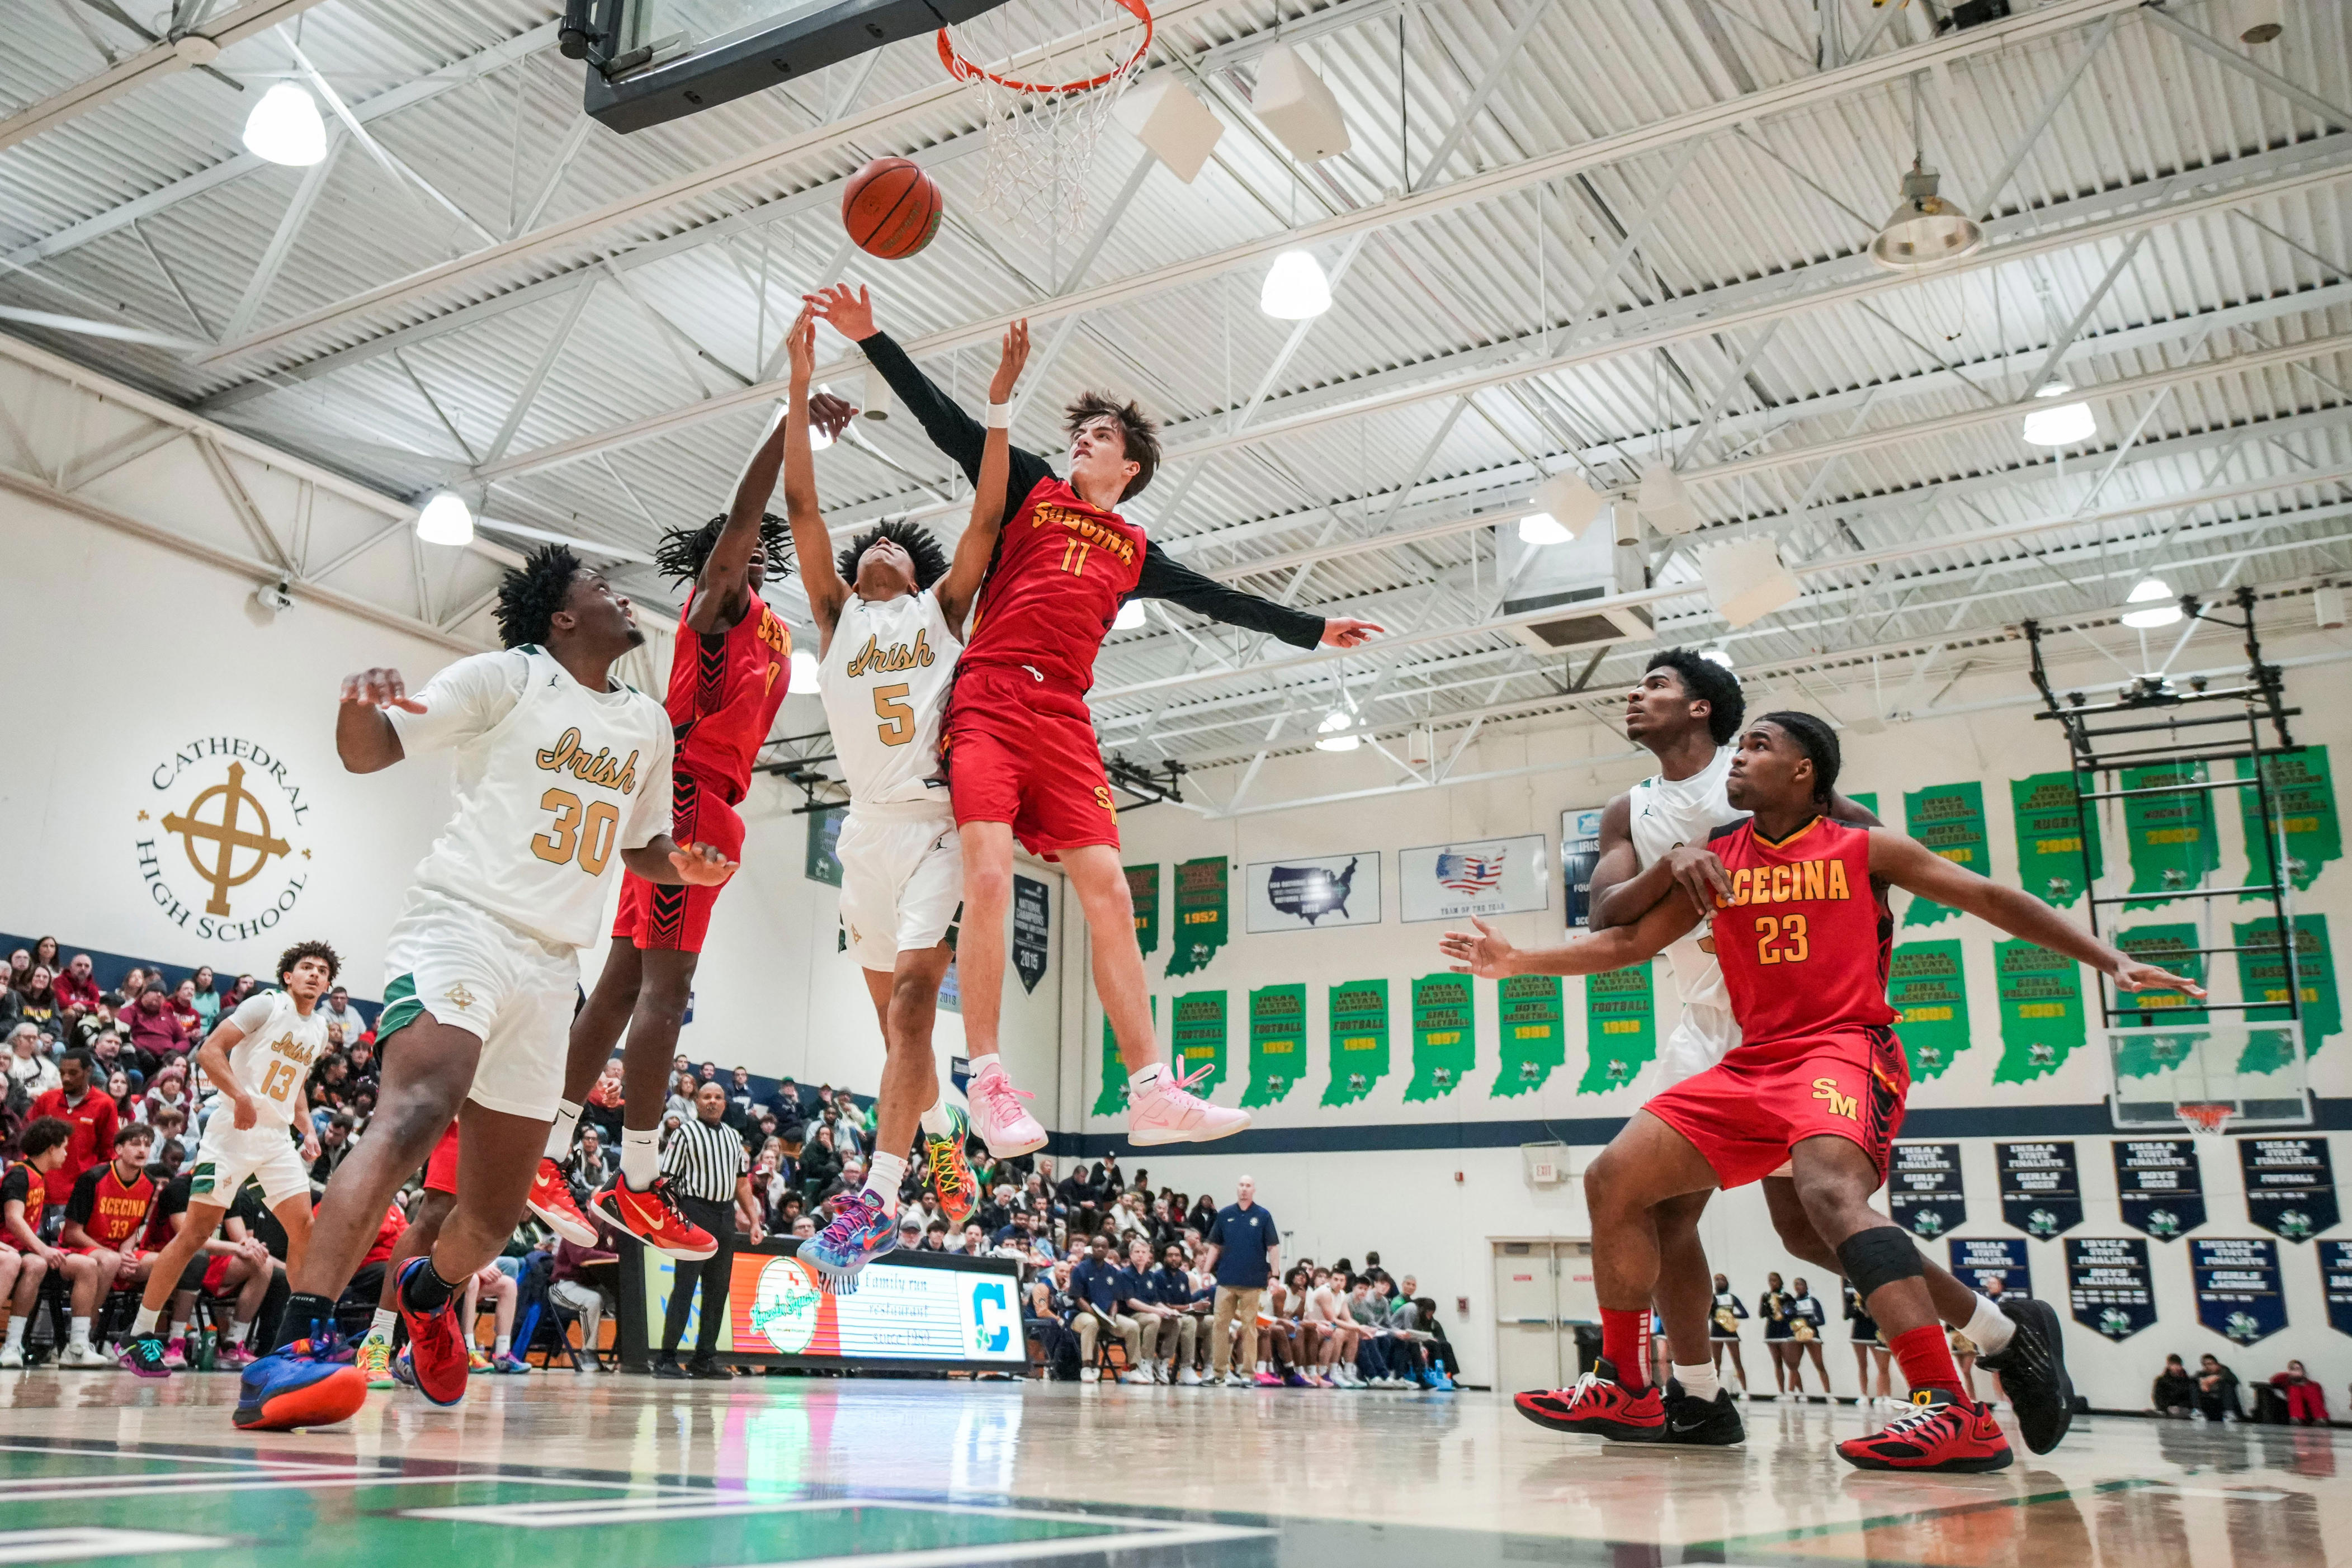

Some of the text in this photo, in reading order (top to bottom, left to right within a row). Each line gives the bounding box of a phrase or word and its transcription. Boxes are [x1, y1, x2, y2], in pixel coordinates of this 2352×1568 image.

[1060, 536, 1090, 577] 11
[848, 628, 935, 678] Irish
[873, 683, 915, 747] 5
[536, 727, 639, 795] Irish
[152, 737, 309, 826] CATHEDRAL
[531, 787, 619, 877] 30
[1579, 840, 1600, 853] IRIS
[136, 838, 307, 942] HIGH SCHOOL
[1184, 911, 1217, 924] 1952
[1755, 914, 1808, 966] 23
[1020, 950, 1038, 970] 2015
[271, 1031, 315, 1066] Irish
[261, 1060, 296, 1102] 13
[1812, 1077, 1858, 1122] SM
[2127, 1142, 2177, 1151] IHSAA
[2256, 1141, 2310, 1150] IHSAA
[2009, 1159, 2065, 1168] FINALISTS
[2126, 1158, 2186, 1166] FINALISTS
[2254, 1156, 2319, 1165] FINALISTS
[1537, 1165, 1551, 1176] EXIT
[2016, 1172, 2060, 1181] GIRLS
[2138, 1171, 2178, 1179] BOYS
[1903, 1174, 1944, 1182] GIRLS
[99, 1196, 146, 1217] SCECINA
[108, 1220, 129, 1239] 33
[2089, 1248, 2124, 1256] STATE
[1963, 1257, 2014, 1265] FINALISTS
[2078, 1256, 2138, 1264] FINALISTS
[2203, 1257, 2268, 1265] FINALISTS
[1973, 1269, 2008, 1279] BOYS
[2090, 1268, 2129, 1277] BOYS
[2212, 1271, 2261, 1279] GIRLS
[866, 1272, 927, 1293] Family run
[2078, 1277, 2142, 1286] VOLLEYBALL
[870, 1302, 928, 1317] restaurant
